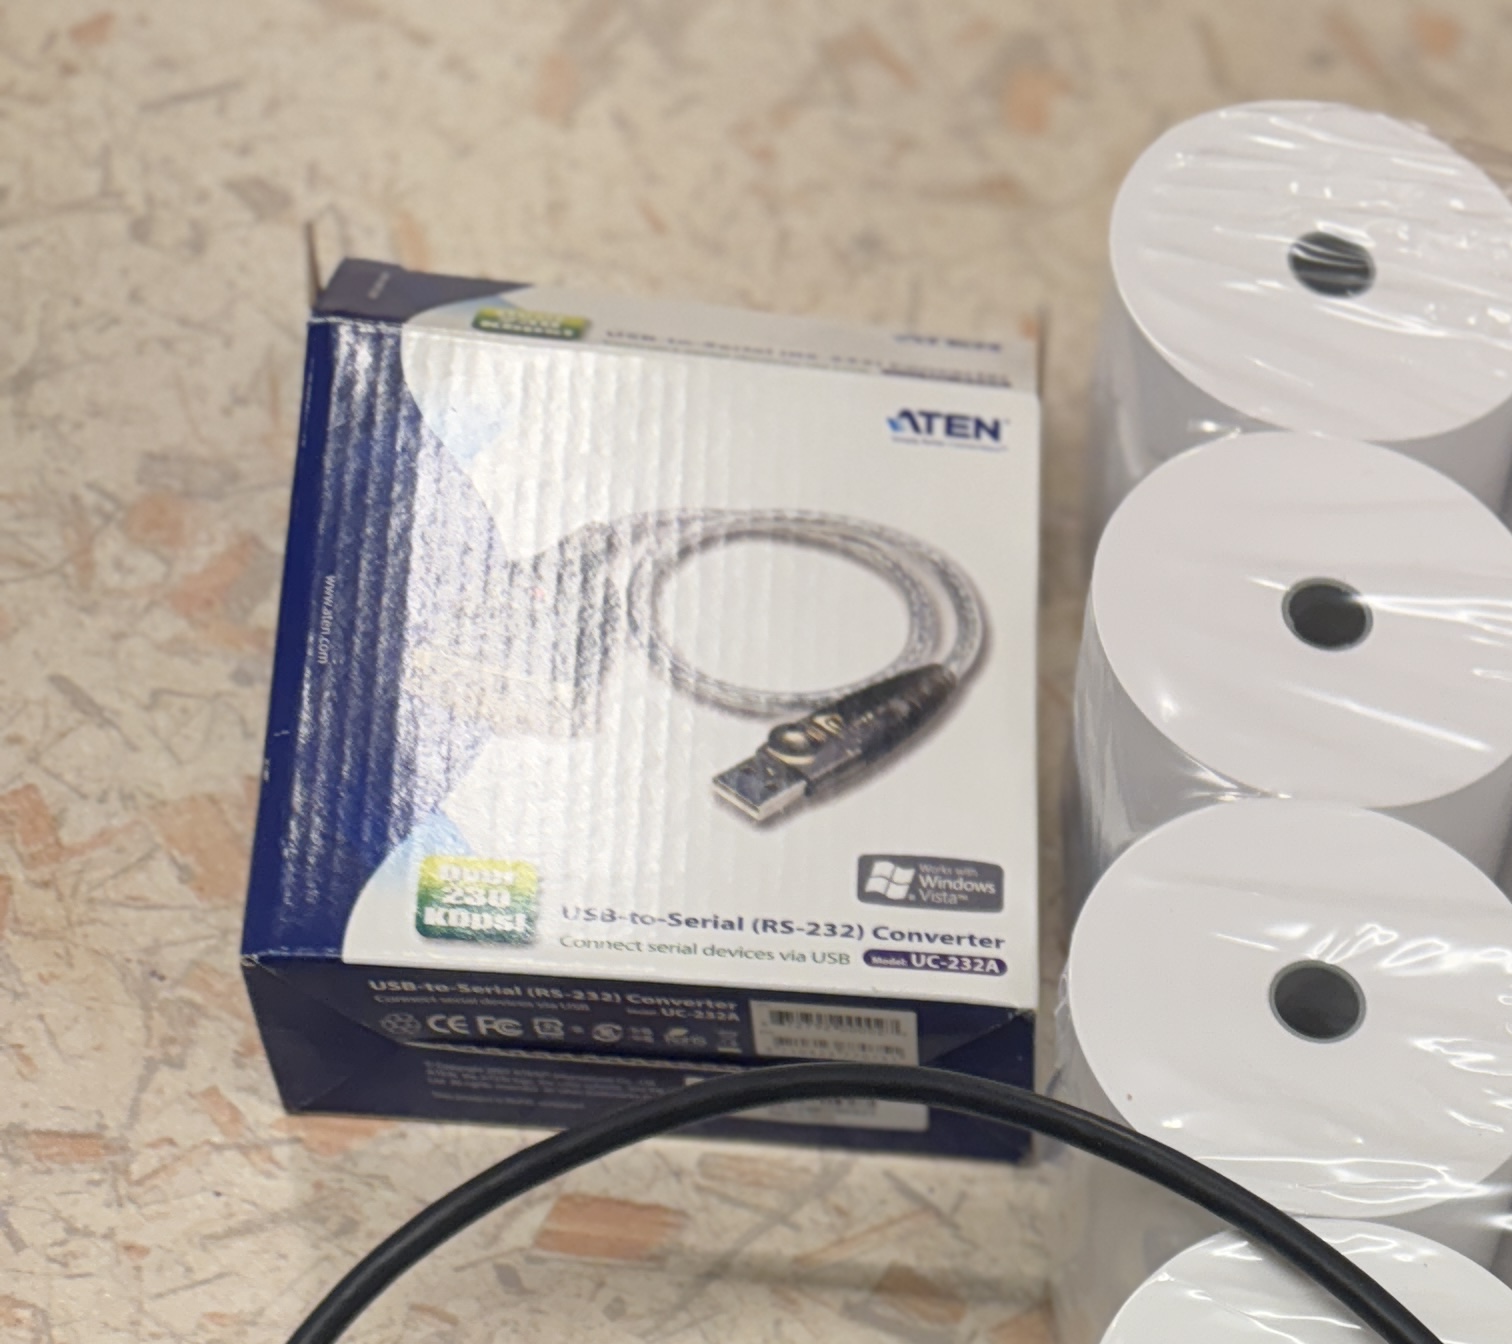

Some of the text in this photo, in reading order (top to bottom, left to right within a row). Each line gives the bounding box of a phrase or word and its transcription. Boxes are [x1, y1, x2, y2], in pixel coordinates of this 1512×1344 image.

[886, 410, 1001, 443] ATEN
[318, 575, 336, 664] www.aten.com
[917, 875, 996, 898] Windows
[562, 905, 1005, 950] USB-to-Serial (RS-232) Converter
[559, 935, 850, 966] Connect serial devices via USB
[911, 950, 1000, 974] UC-232A
[626, 993, 738, 1011] Converter
